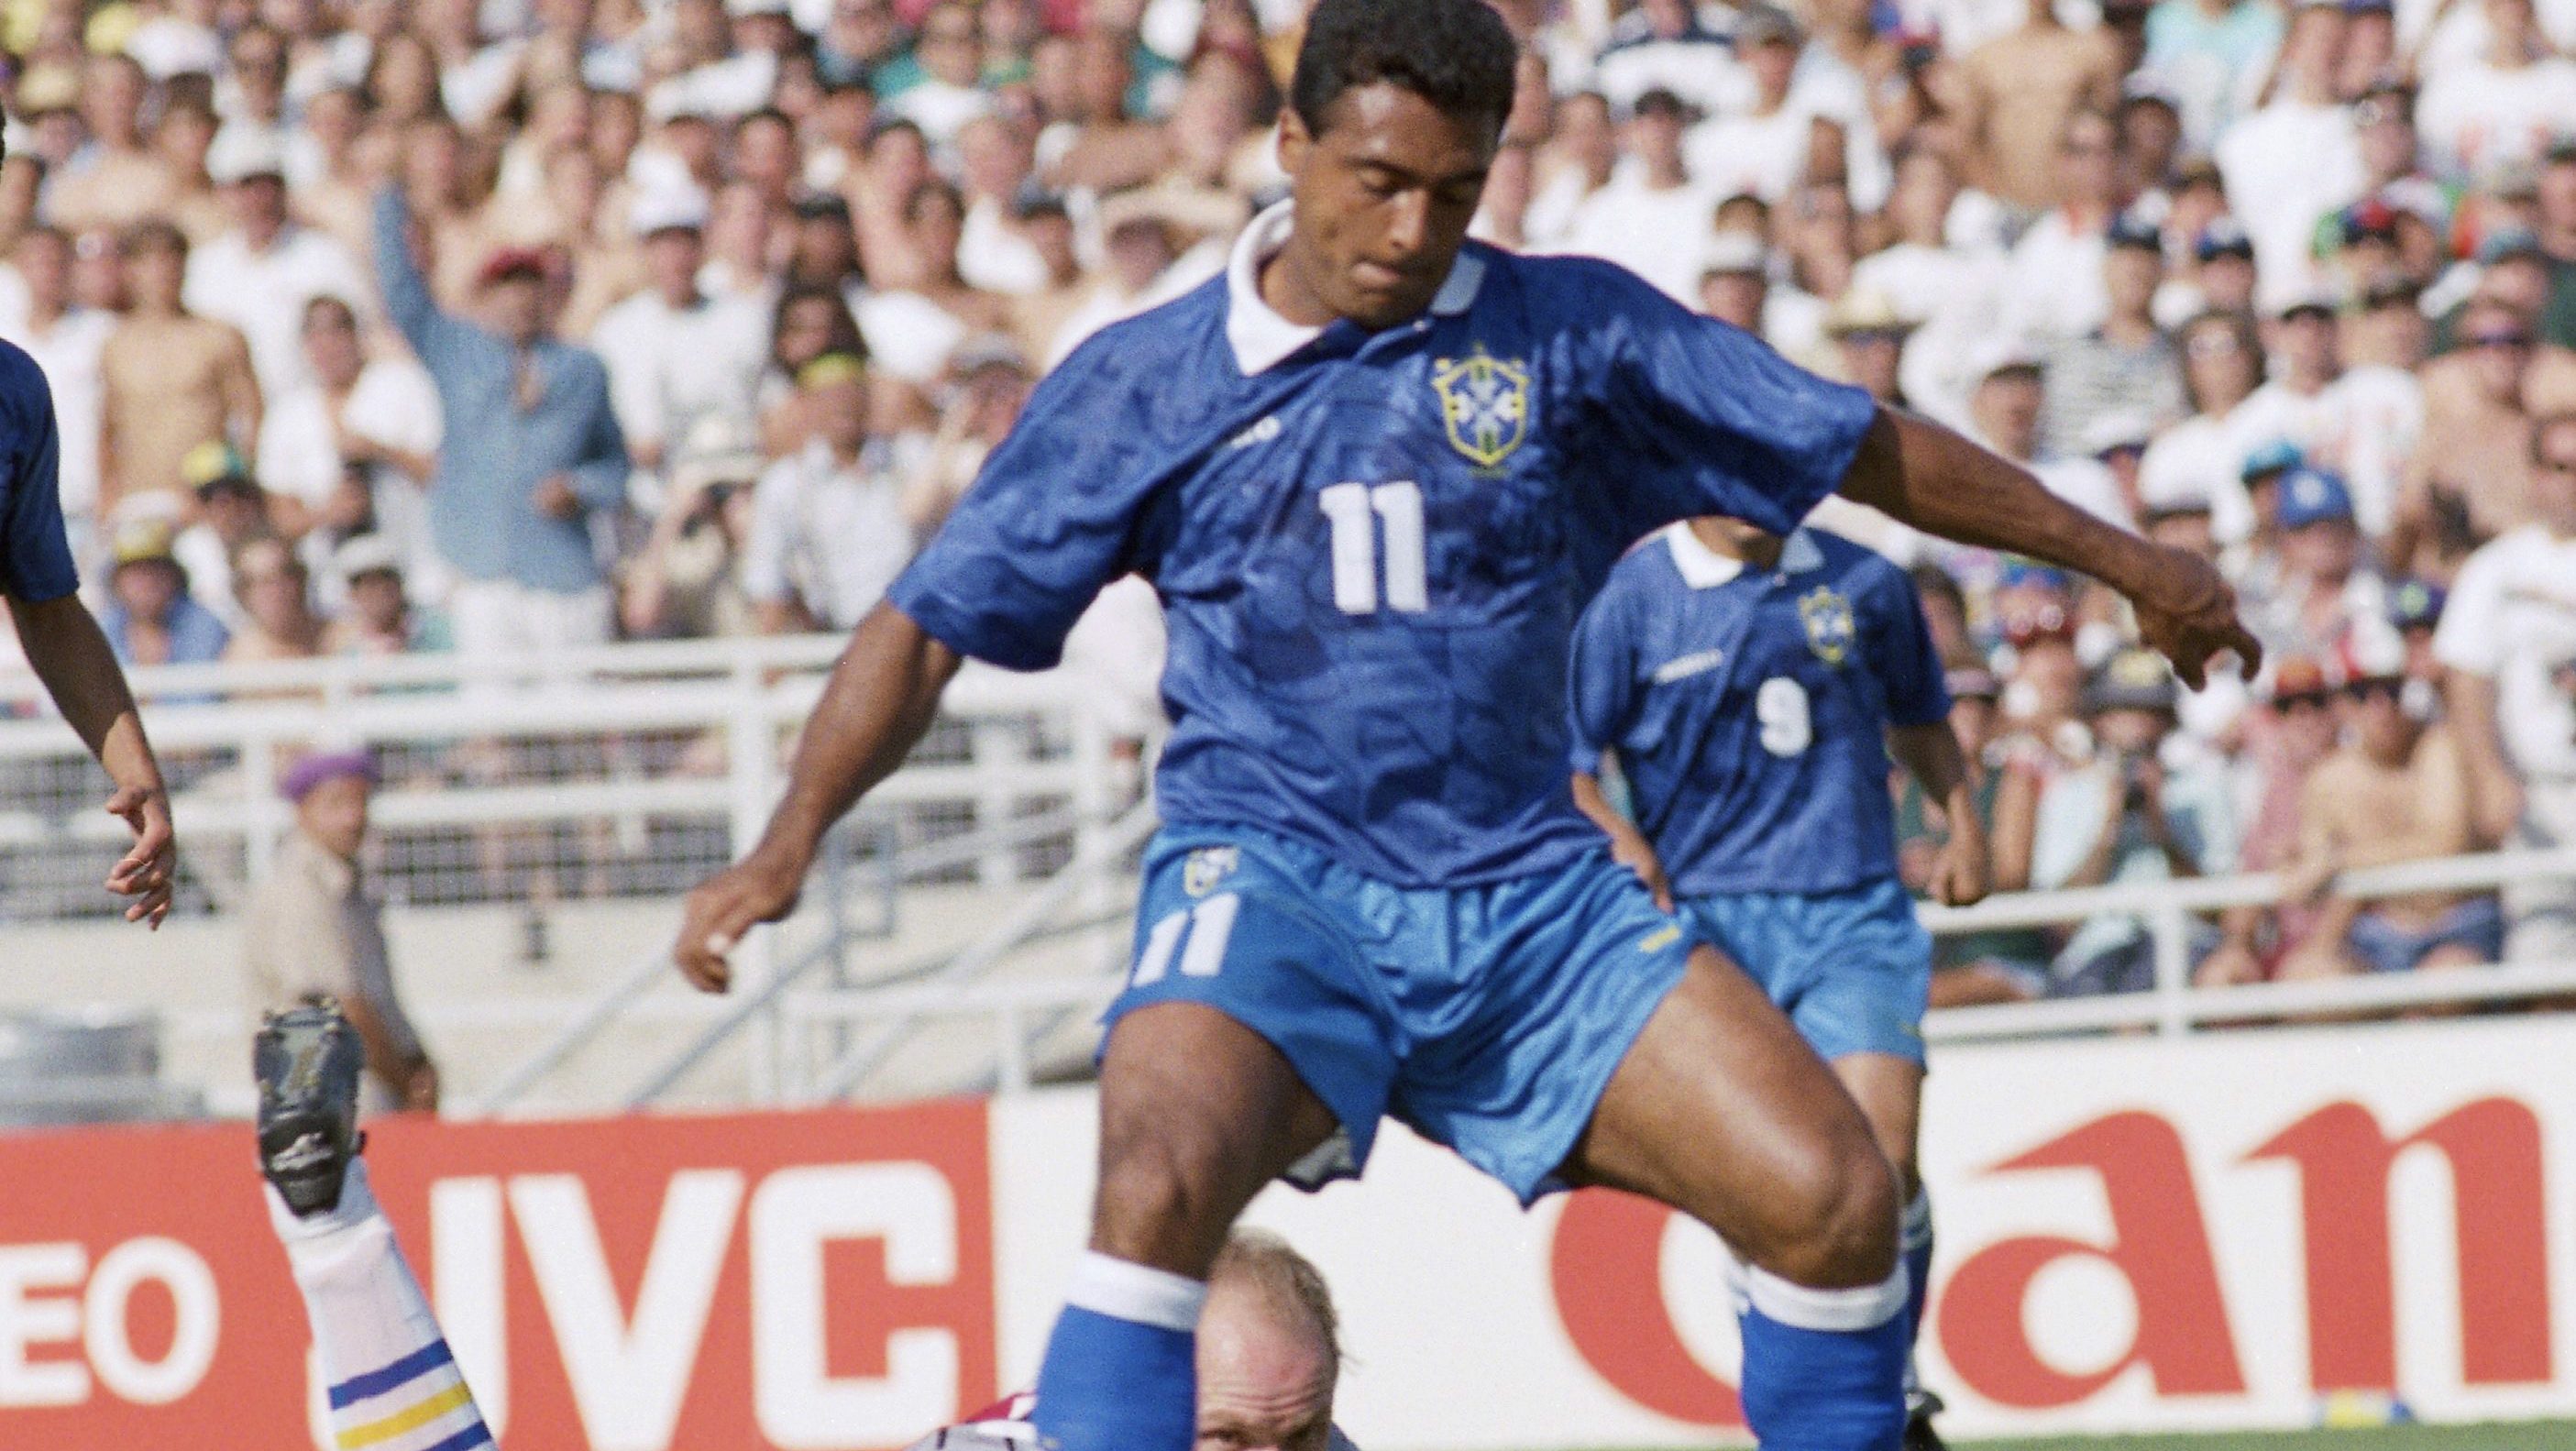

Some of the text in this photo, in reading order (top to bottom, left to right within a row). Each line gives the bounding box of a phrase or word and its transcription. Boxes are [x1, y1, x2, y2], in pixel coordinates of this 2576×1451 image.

[1319, 480, 1428, 614] 11
[1756, 676, 1812, 758] 9
[1133, 892, 1239, 987] 11
[305, 1164, 958, 1451] JVC
